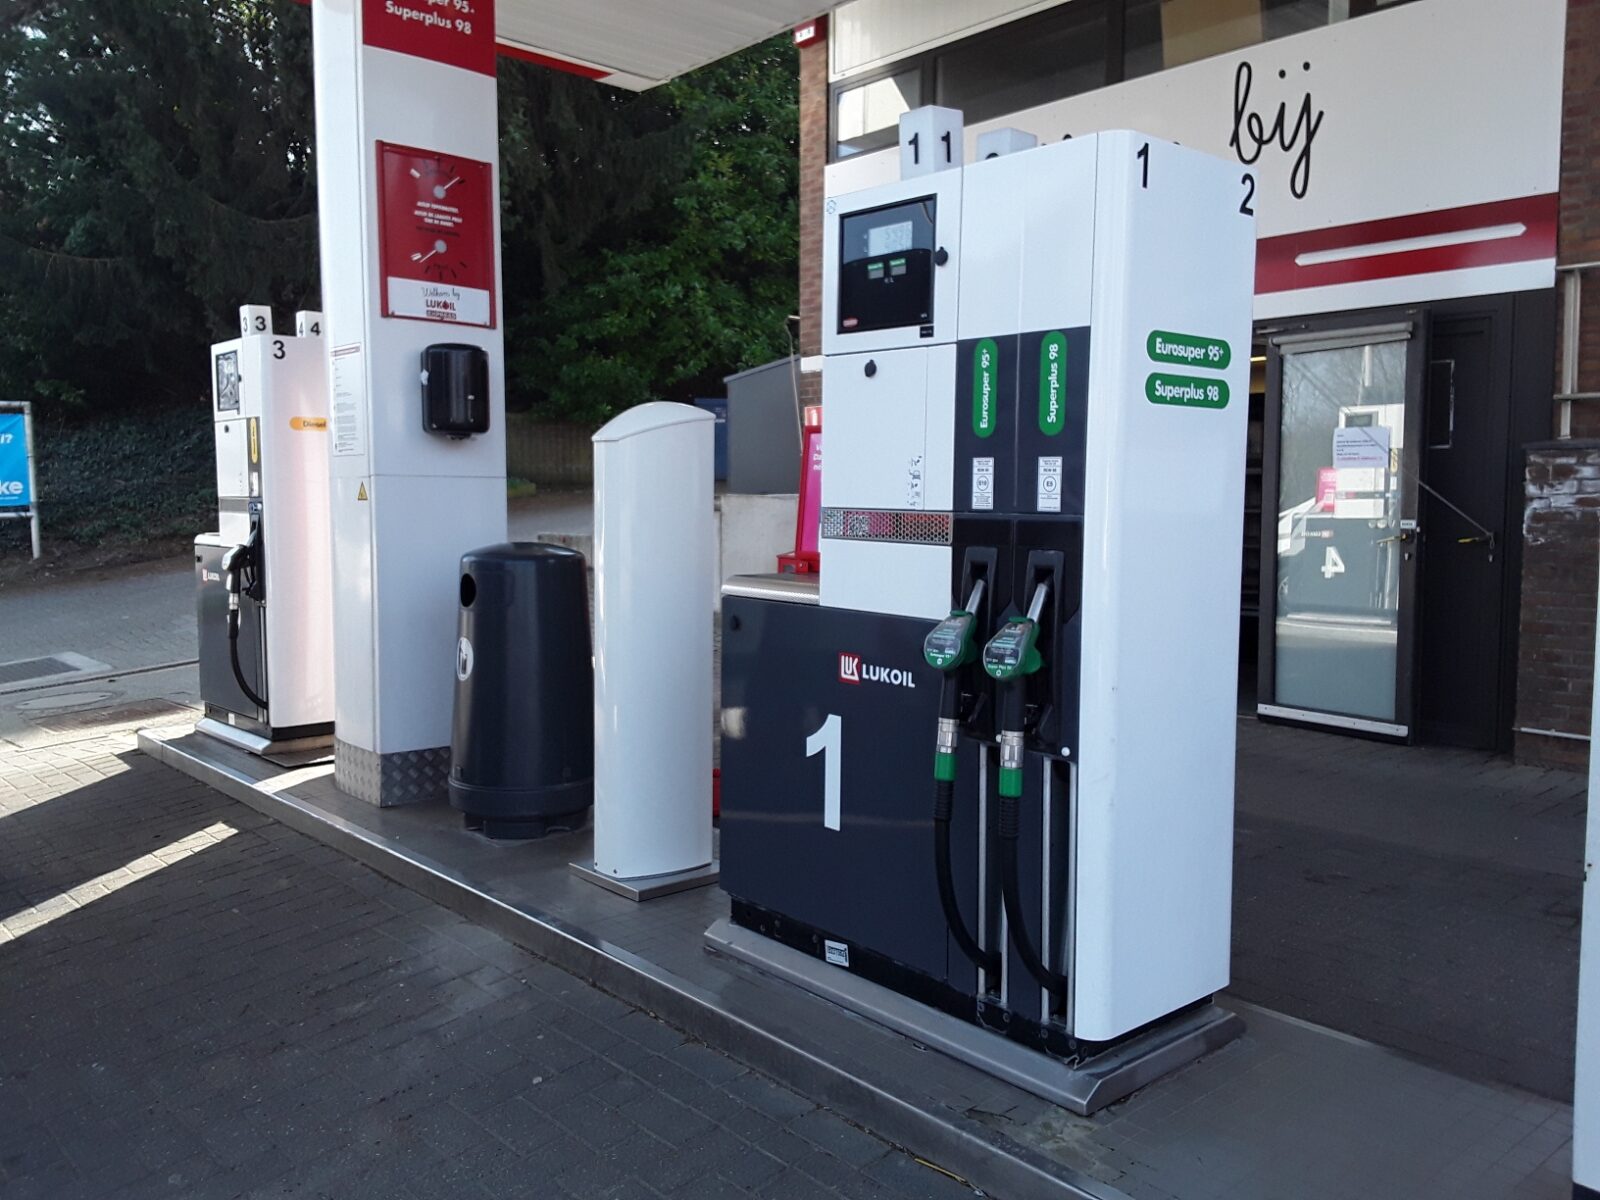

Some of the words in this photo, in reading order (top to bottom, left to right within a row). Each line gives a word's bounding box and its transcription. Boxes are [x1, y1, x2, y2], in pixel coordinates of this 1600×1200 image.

[385, 0, 452, 28] Superplus
[455, 19, 472, 34] 98
[941, 130, 951, 163] 1
[1229, 61, 1325, 200] bij
[908, 132, 919, 164] 1
[1137, 142, 1150, 189] 1
[1239, 173, 1255, 216] 2
[425, 299, 456, 311] LUKOIL
[255, 315, 267, 332] 3
[310, 321, 321, 336] 4
[272, 340, 286, 360] 3
[1048, 343, 1059, 360] 98
[1155, 337, 1206, 362] Eurosuper
[980, 371, 991, 429] Eurosuper
[1046, 362, 1059, 424] Superplus
[1154, 379, 1205, 403] Superplus
[1206, 385, 1219, 402] 98
[862, 664, 916, 688] LUKOIL
[806, 713, 842, 832] 1
